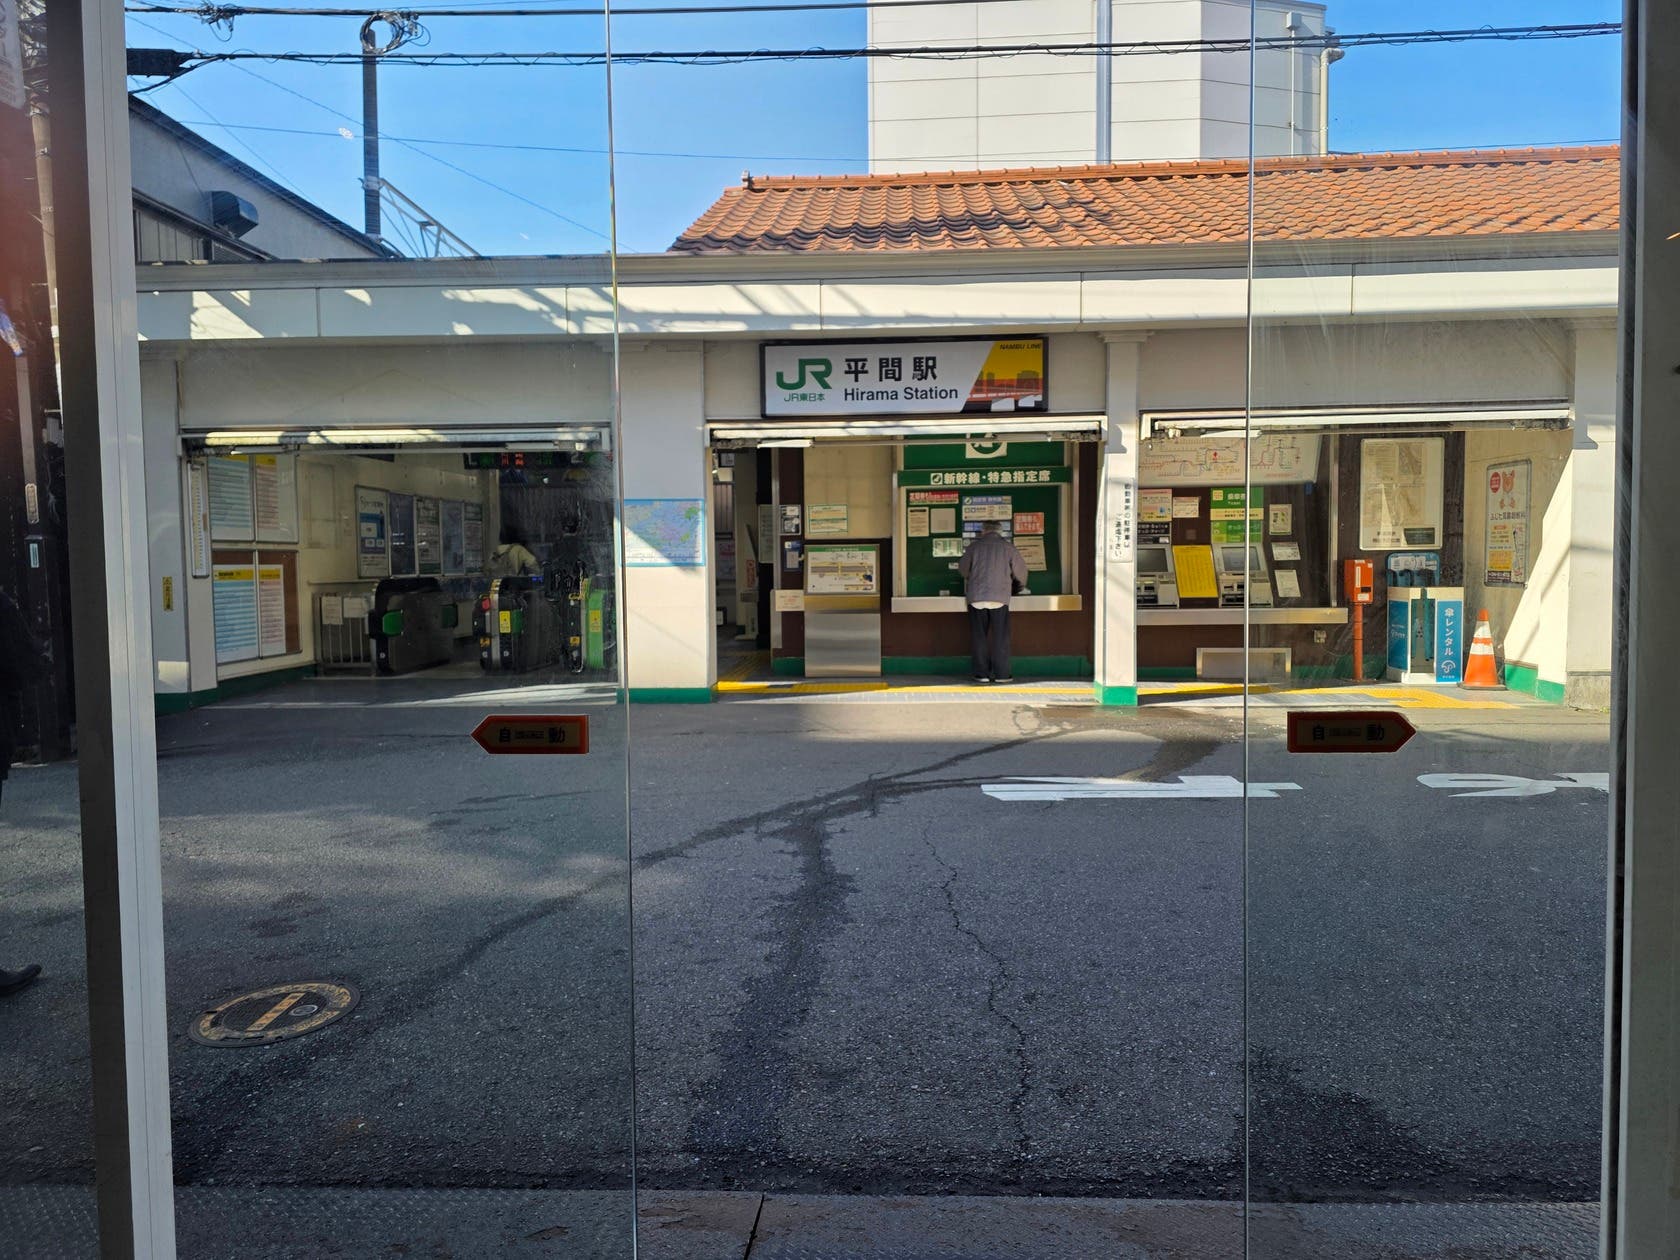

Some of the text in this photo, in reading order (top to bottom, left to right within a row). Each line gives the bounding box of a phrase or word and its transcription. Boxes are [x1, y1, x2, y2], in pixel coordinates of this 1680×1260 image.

[776, 358, 832, 390] JR
[844, 356, 937, 382] 平間駅
[783, 392, 825, 402] JR東日本
[844, 386, 958, 401] Hirama Station
[944, 470, 1050, 485] 新幹線・特急指定席
[1444, 607, 1455, 656] 傘レンタル
